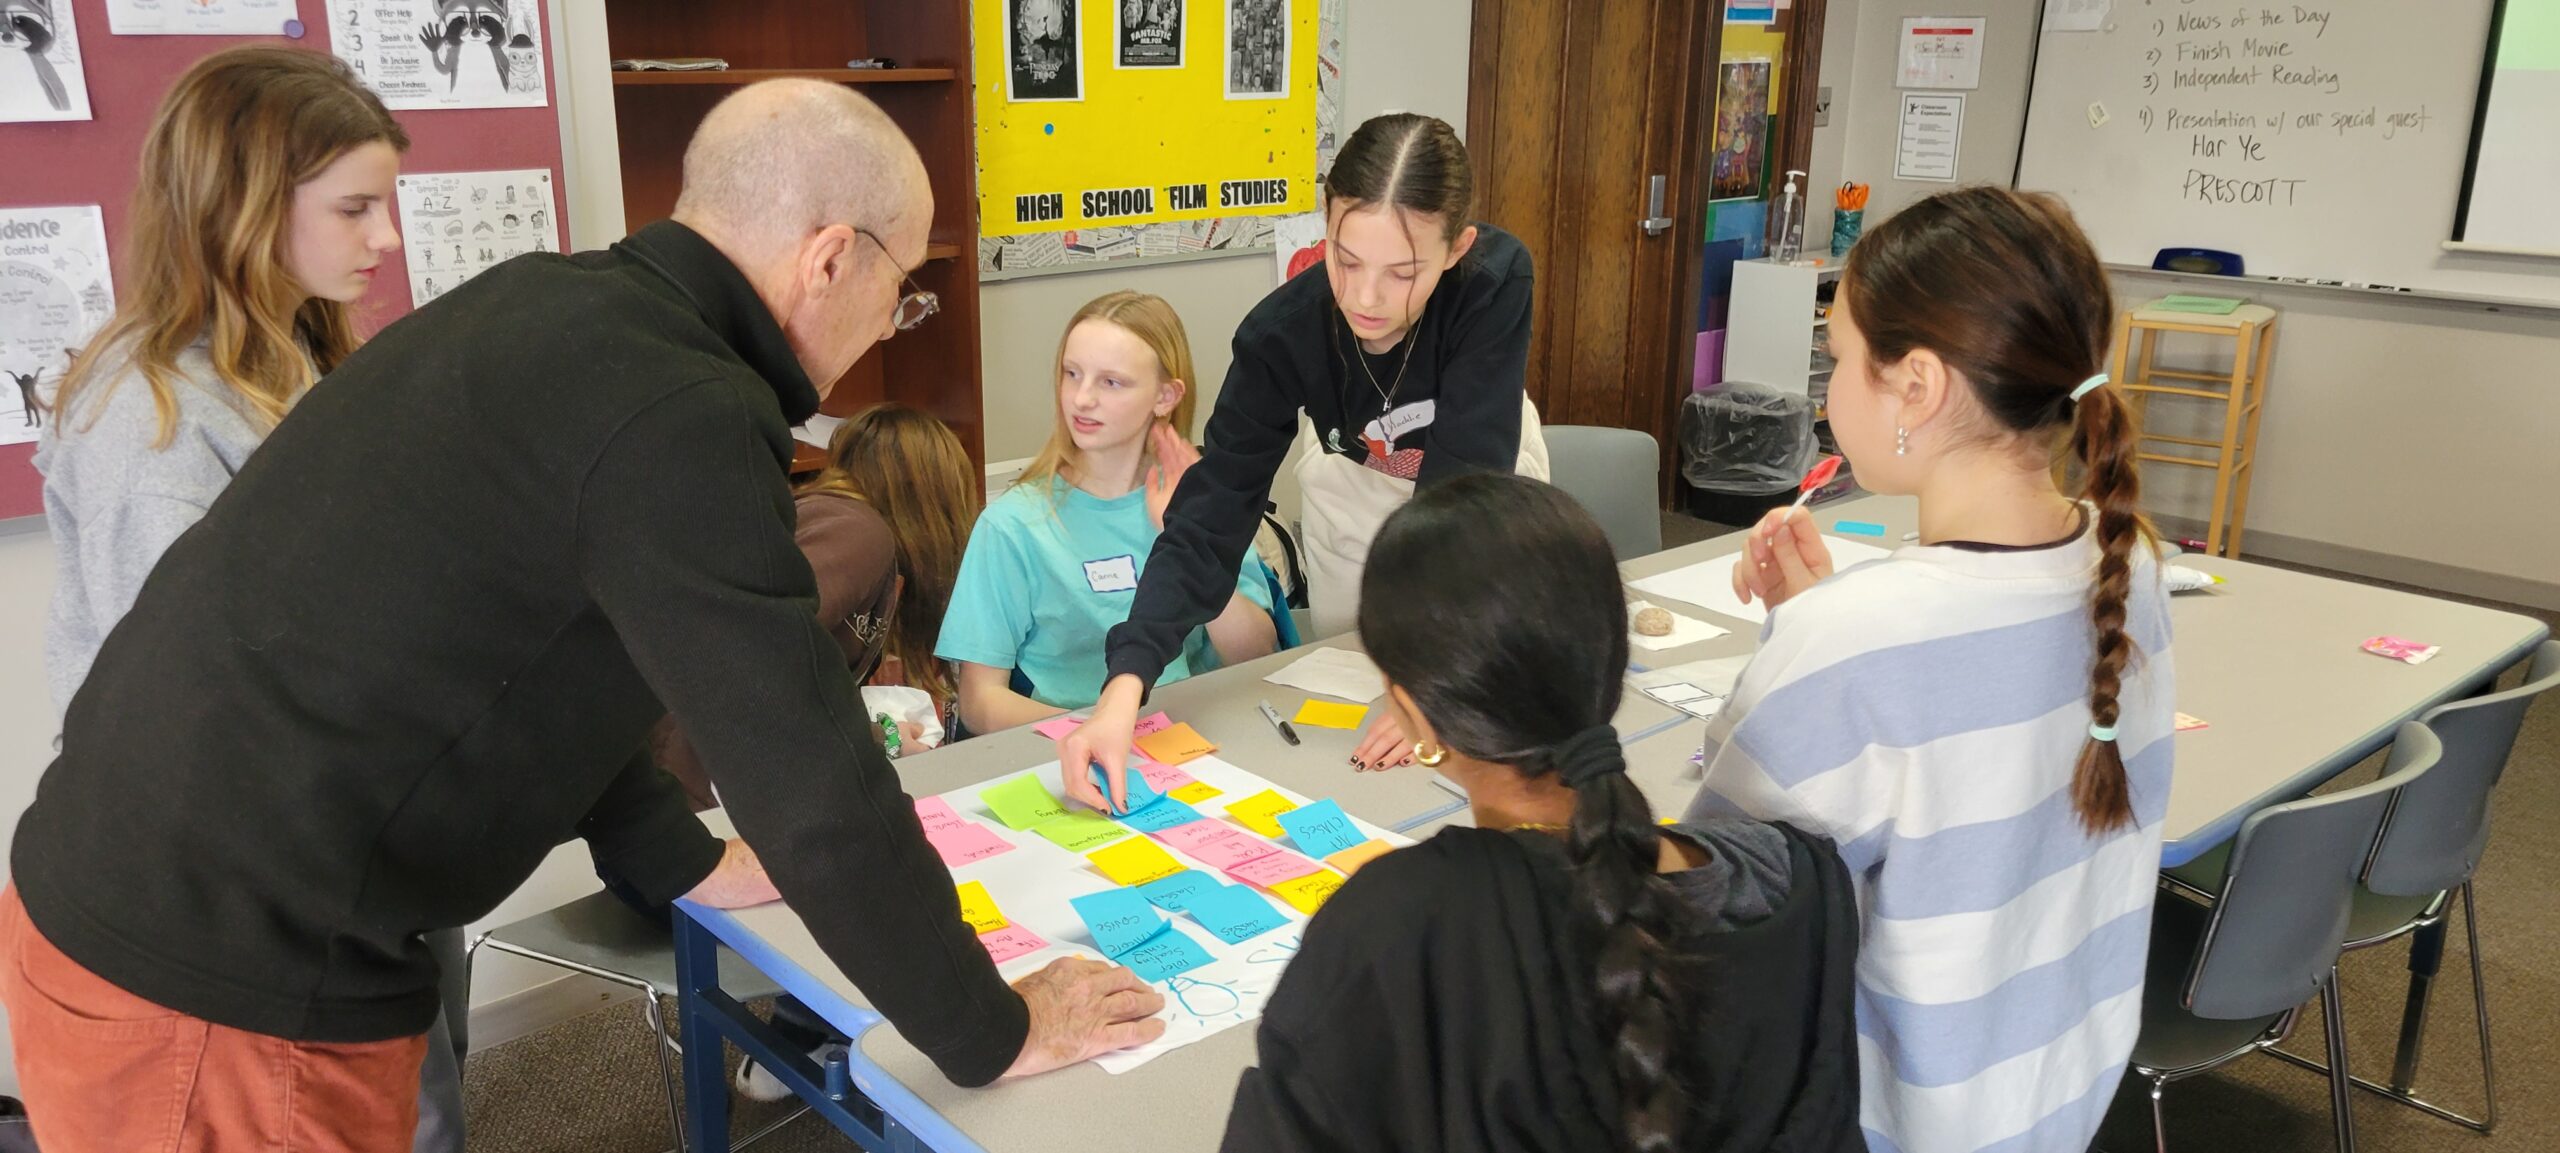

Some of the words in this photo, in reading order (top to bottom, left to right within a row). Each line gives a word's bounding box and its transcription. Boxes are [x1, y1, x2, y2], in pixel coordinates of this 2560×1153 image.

[349, 10, 360, 26] 2
[2176, 11, 2222, 32] News
[2231, 8, 2250, 28] of
[2260, 9, 2285, 27] the
[2292, 5, 2331, 39] Day
[352, 34, 363, 51] 3
[1130, 29, 1172, 41] FANTASTIC
[2176, 40, 2231, 62] Finish
[2242, 38, 2294, 58] Movie
[355, 60, 366, 75] 4
[2142, 72, 2159, 95] 3)
[2174, 65, 2263, 92] Independent
[2272, 64, 2341, 94] Reading
[2139, 105, 2154, 133] 4)
[2167, 108, 2257, 131] Presentation
[2266, 112, 2286, 135] w/
[2297, 112, 2324, 129] our
[2331, 106, 2376, 136] special
[2382, 104, 2433, 140] guest
[2192, 134, 2227, 157] Har
[2239, 134, 2266, 161] Ye
[2182, 168, 2307, 207] PRESCOTT
[1016, 193, 1063, 222] HIGH
[1082, 188, 1154, 218] SCHOOL
[1169, 184, 1207, 210] FILM
[1220, 179, 1287, 206] STUDIES
[5, 244, 49, 256] Control
[8, 265, 53, 286] Control
